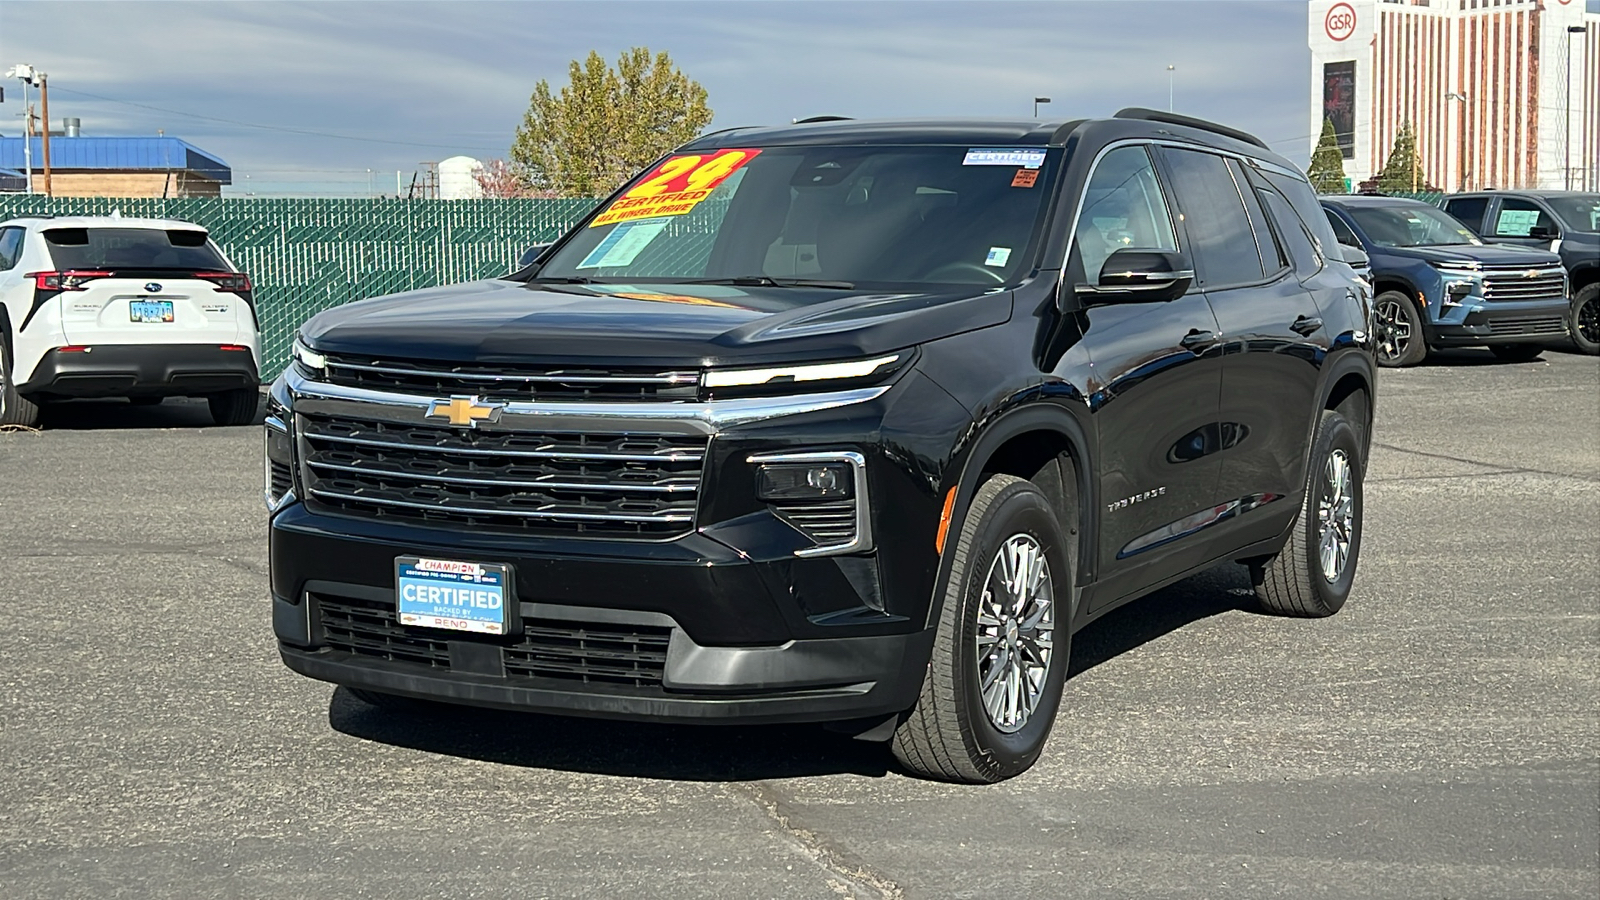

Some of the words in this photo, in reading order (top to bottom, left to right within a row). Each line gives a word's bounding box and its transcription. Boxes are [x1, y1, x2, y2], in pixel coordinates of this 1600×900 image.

[1329, 13, 1351, 30] GSR
[969, 153, 1042, 161] CERTIFIED
[626, 151, 746, 198] 24
[610, 190, 707, 211] CERTIFIED
[594, 213, 617, 223] ALL
[617, 207, 655, 219] WHEEL
[655, 203, 694, 214] DRIVE
[1107, 486, 1166, 512] TRAVERSE
[406, 569, 429, 577] CERTIFIED
[424, 561, 475, 573] CHAMPION
[403, 584, 501, 609] CERTIFIED
[434, 606, 461, 615] BACKED
[435, 618, 467, 628] RENO
